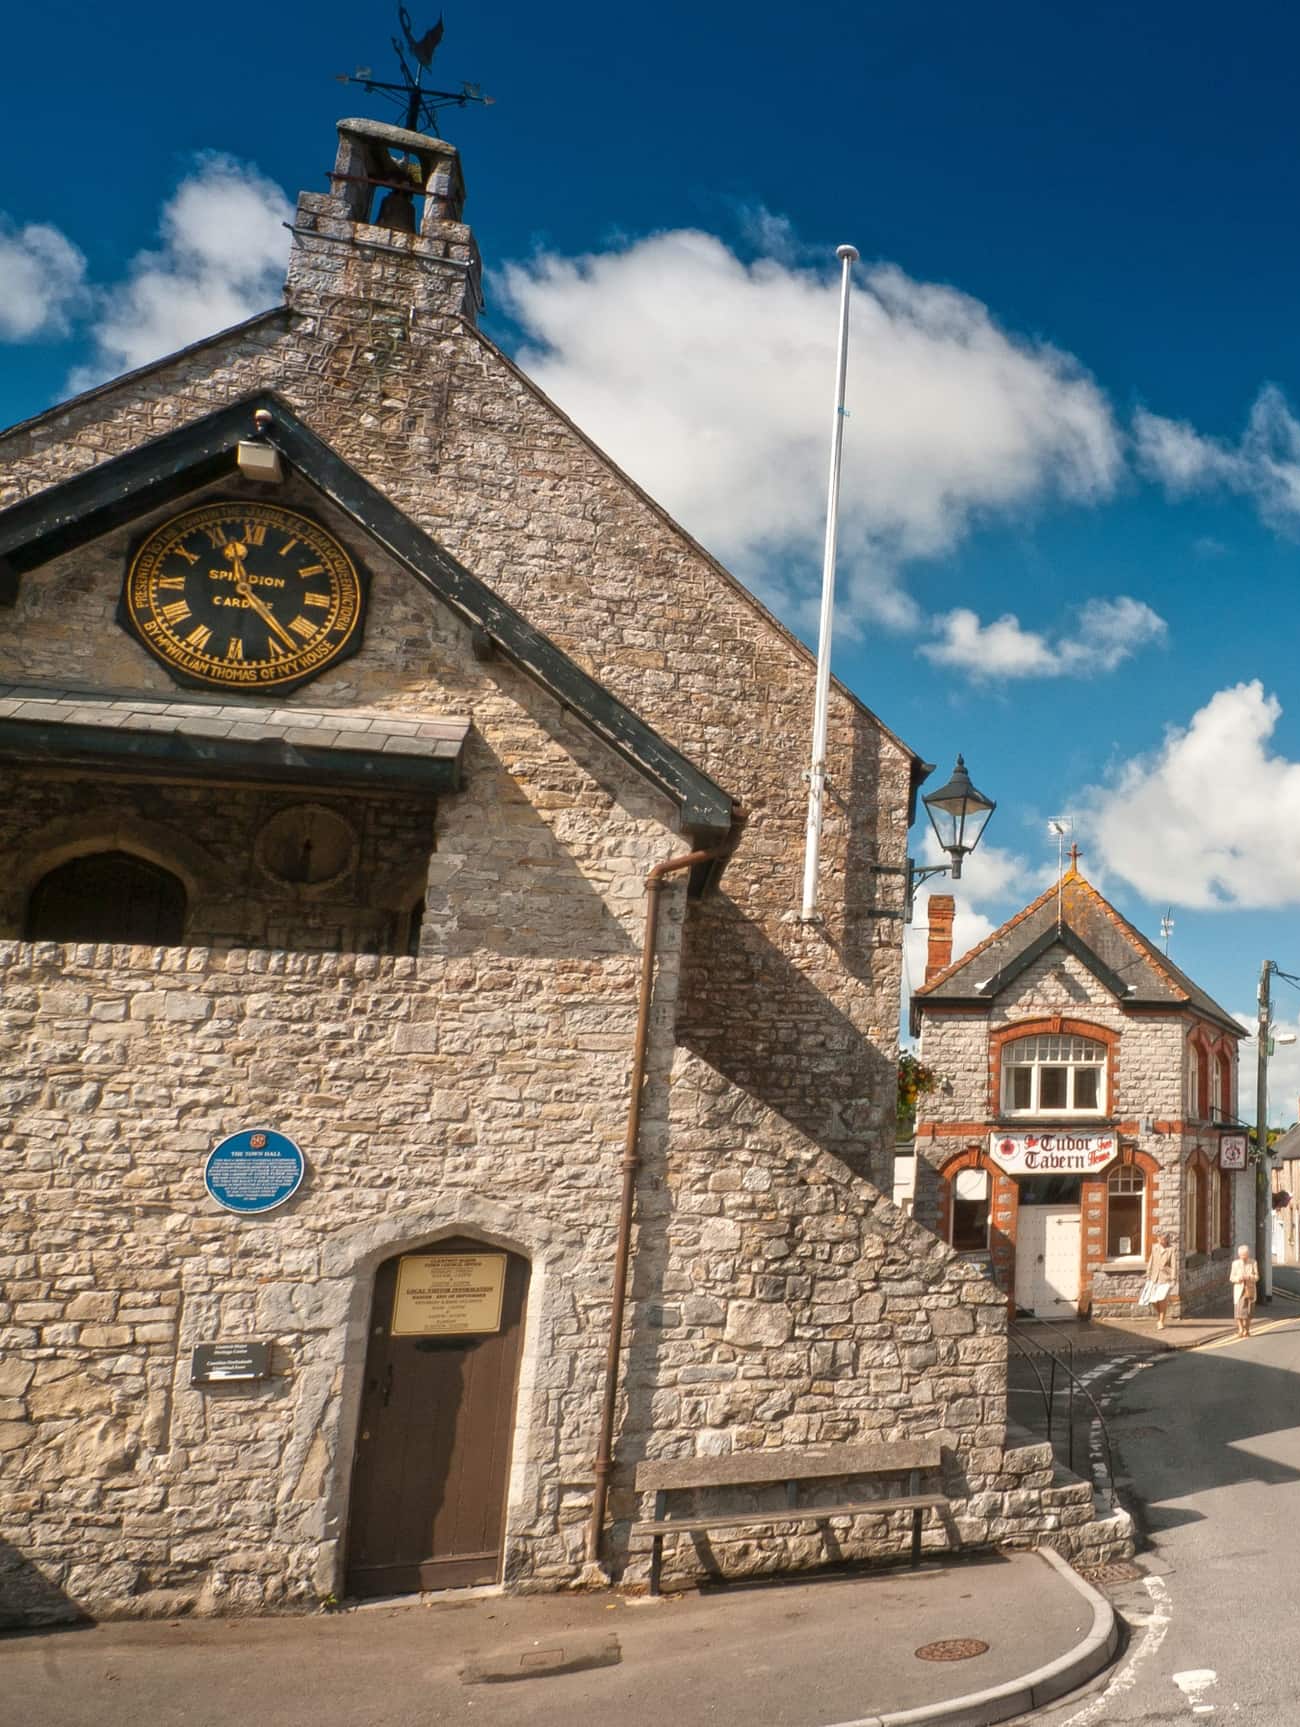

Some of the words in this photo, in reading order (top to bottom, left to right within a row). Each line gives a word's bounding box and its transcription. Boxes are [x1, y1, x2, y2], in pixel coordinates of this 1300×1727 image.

[243, 525, 267, 545] XII
[176, 545, 200, 565] X
[333, 589, 355, 631] VICTORIA
[143, 620, 159, 637] BY
[168, 643, 209, 675] WILLIAM
[210, 667, 257, 681] THOMAS
[260, 668, 275, 679] OF
[275, 661, 298, 677] IVY
[298, 639, 336, 668] HOUSE
[1040, 1134, 1092, 1152] Tudor
[1024, 1151, 1085, 1170] Tavern
